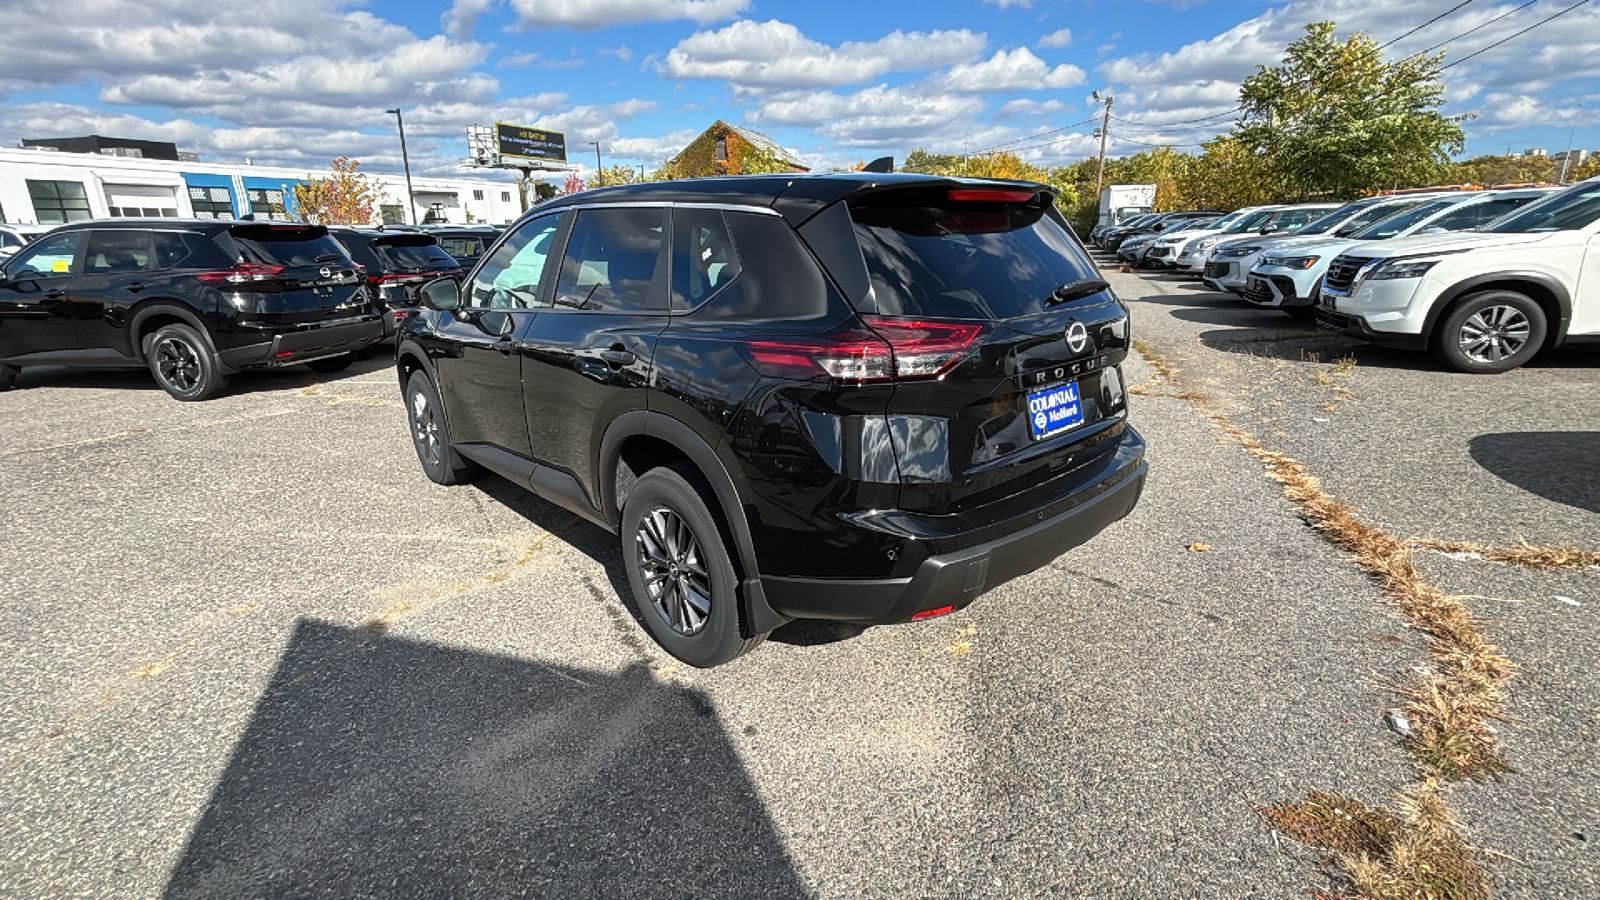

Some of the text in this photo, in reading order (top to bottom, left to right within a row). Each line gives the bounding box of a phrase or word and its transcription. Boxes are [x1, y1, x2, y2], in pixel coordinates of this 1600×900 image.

[1036, 356, 1108, 383] ROGUE
[1030, 388, 1077, 413] COLONIAL
[1049, 404, 1077, 422] Medford
